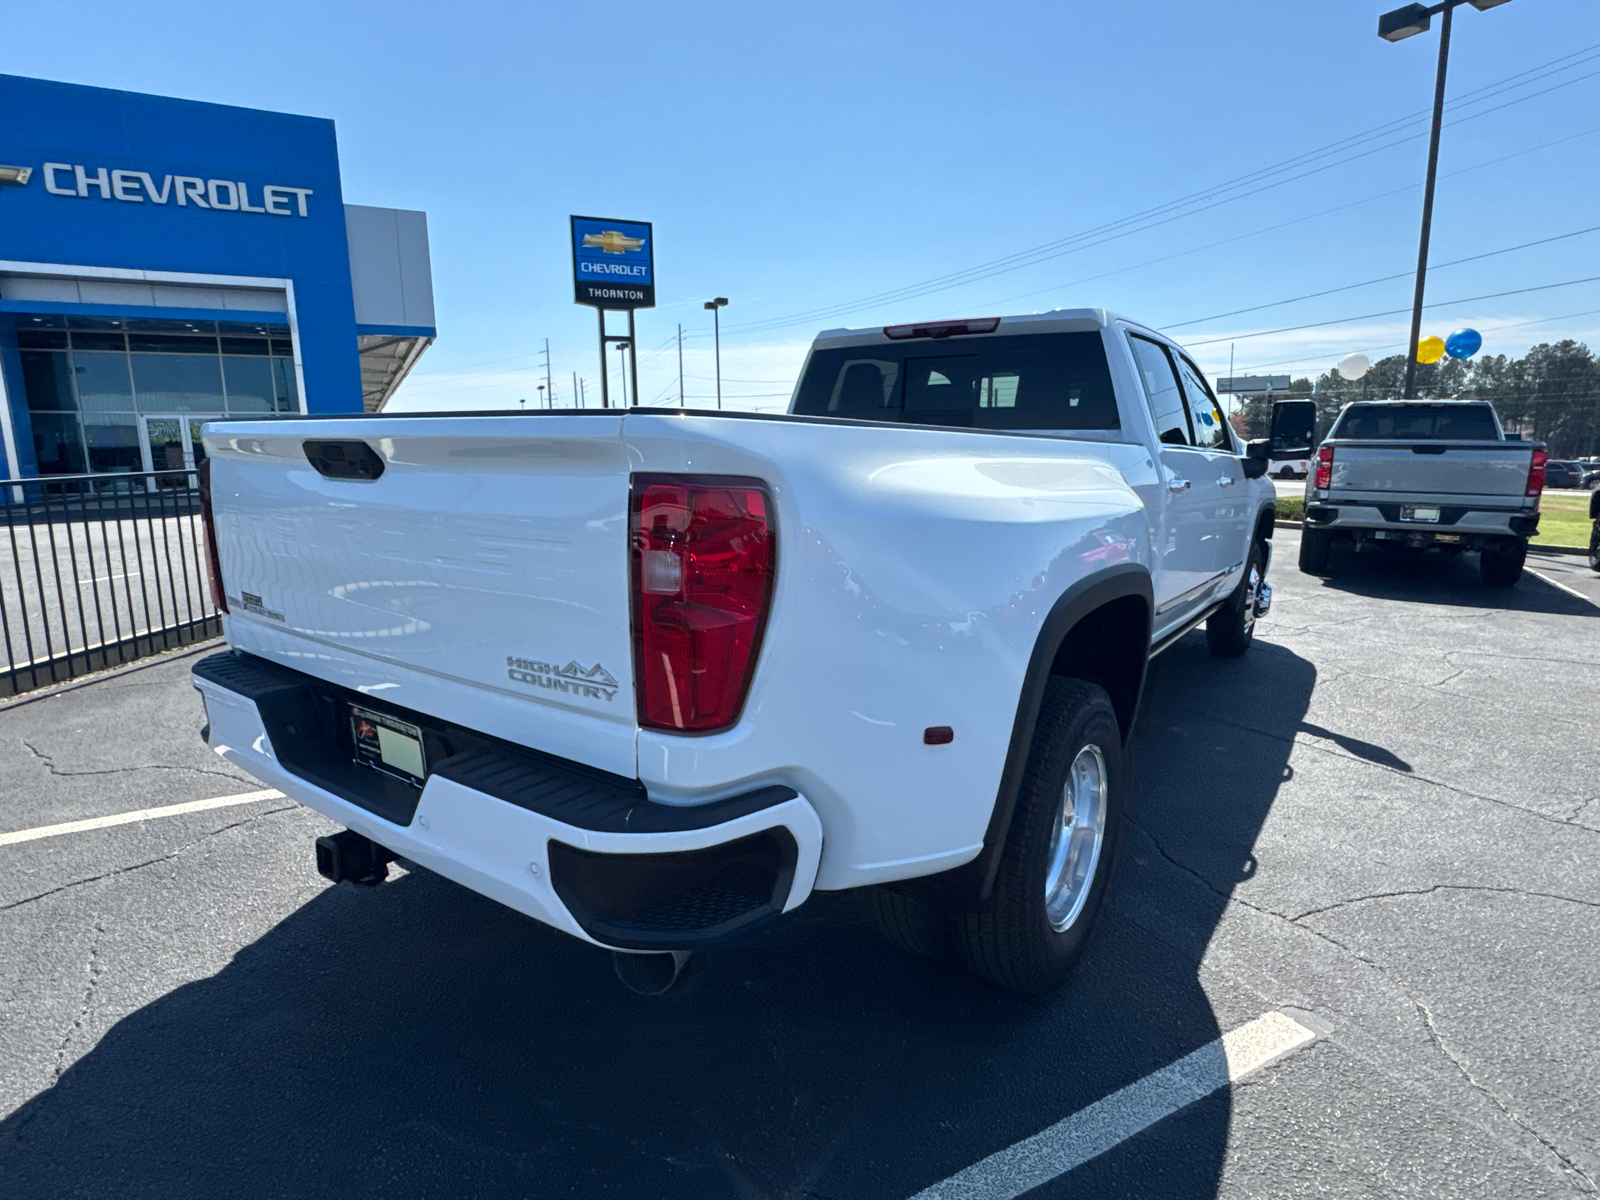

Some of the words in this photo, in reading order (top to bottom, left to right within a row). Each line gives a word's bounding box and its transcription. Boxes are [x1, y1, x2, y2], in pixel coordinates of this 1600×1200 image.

[42, 162, 313, 217] CHEVROLET
[581, 262, 647, 276] CHEVROLET
[588, 288, 644, 300] THORNTON
[506, 655, 560, 677] HIGH
[508, 668, 618, 702] COUNTRY
